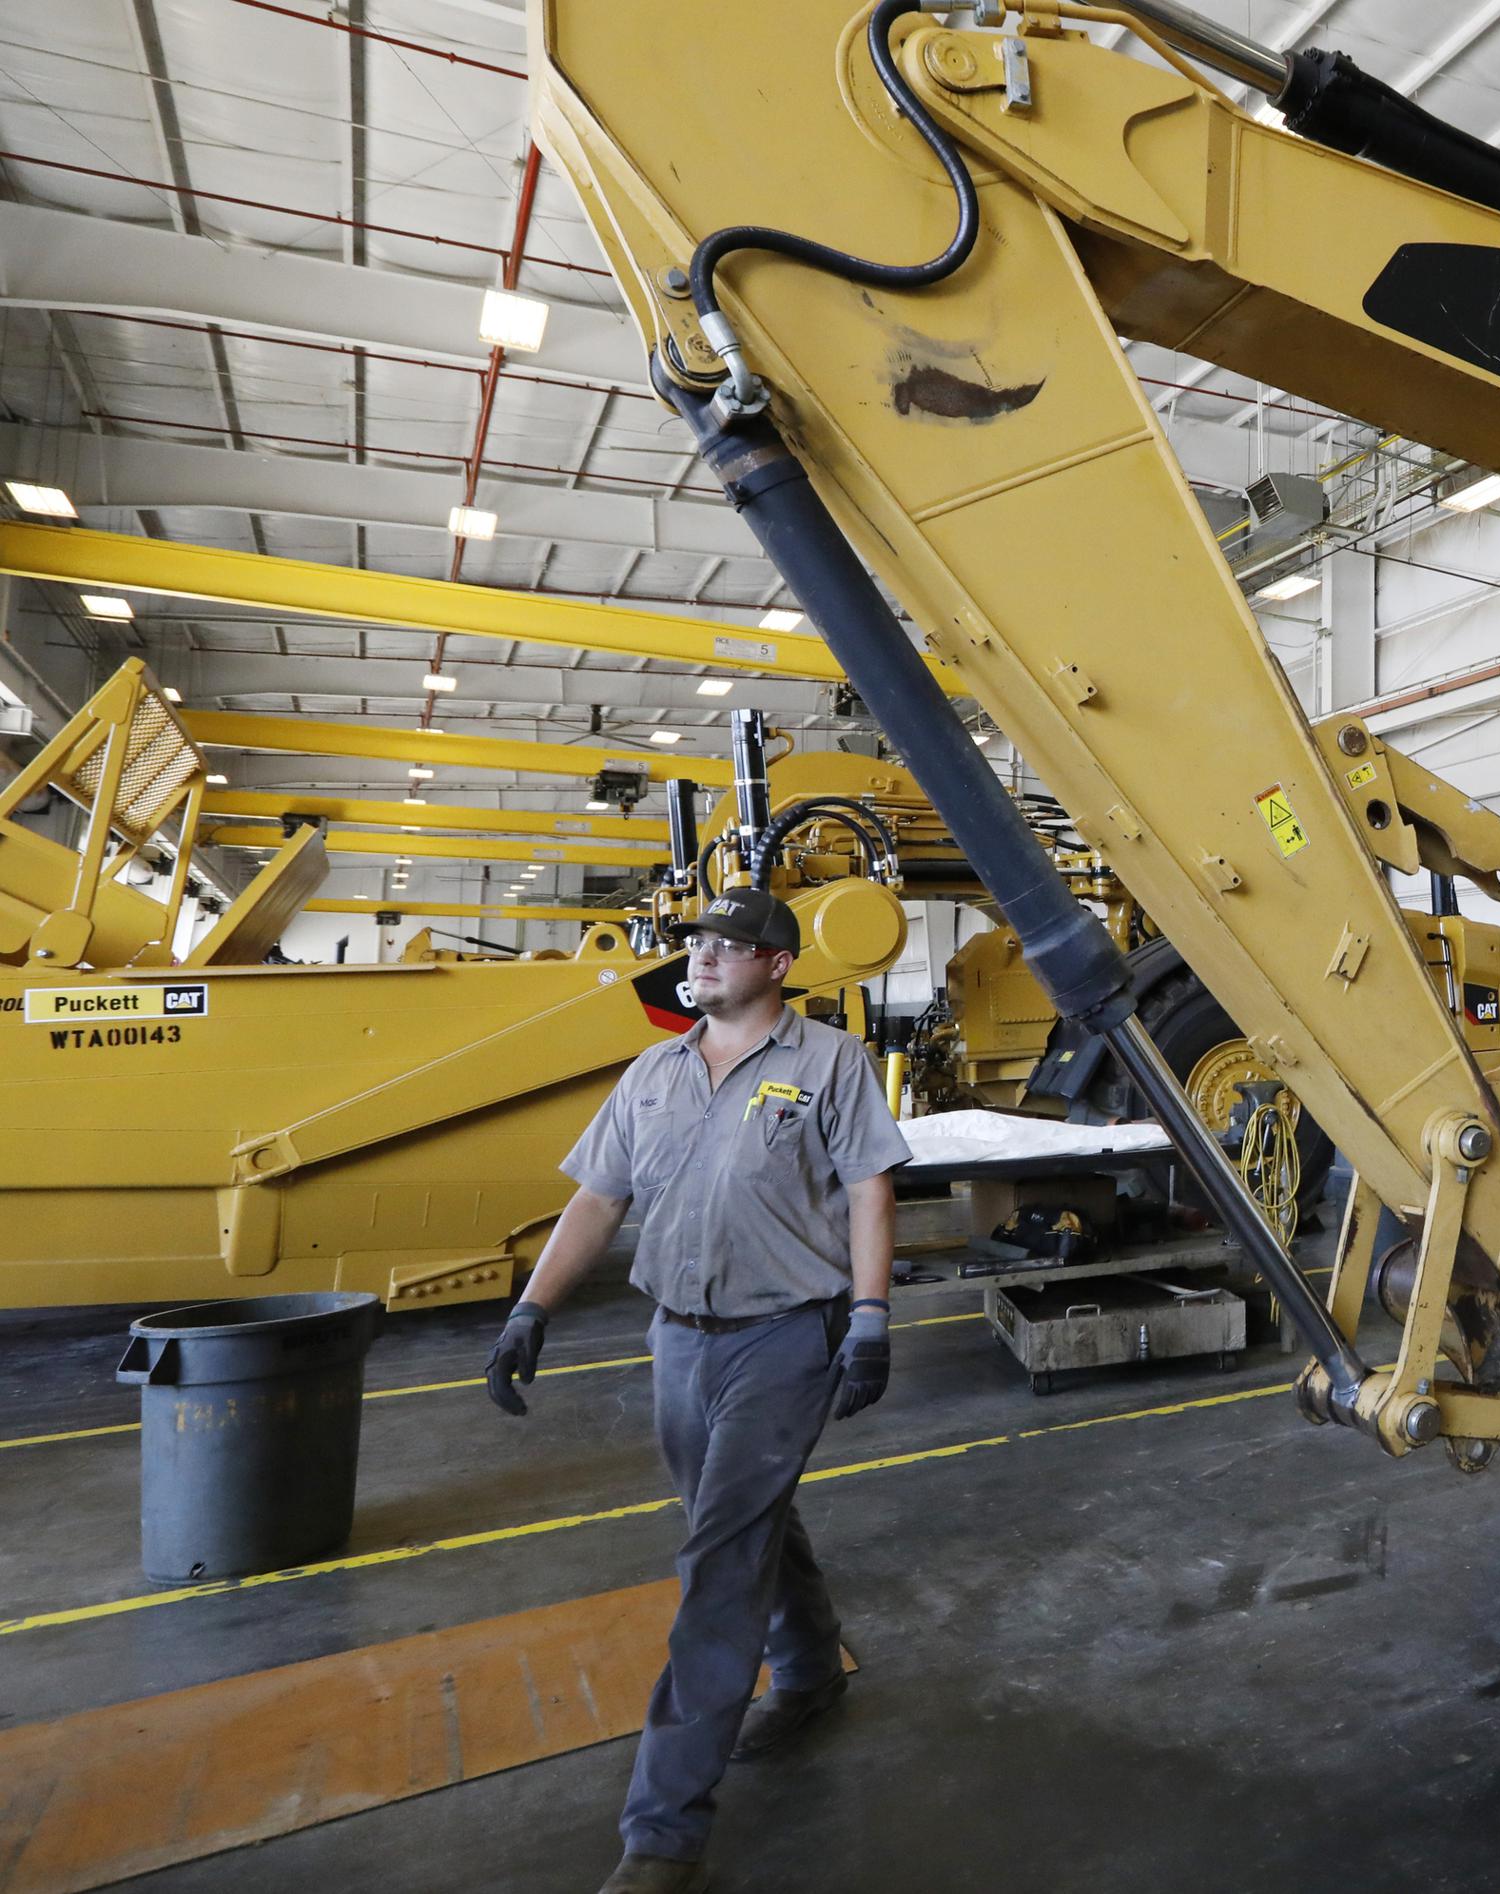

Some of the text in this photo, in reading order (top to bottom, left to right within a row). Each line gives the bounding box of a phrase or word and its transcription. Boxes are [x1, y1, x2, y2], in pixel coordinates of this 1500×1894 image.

[707, 899, 740, 917] CAT
[54, 991, 204, 1013] Puckett CAT
[1477, 1003, 1498, 1020] CAT
[50, 1025, 182, 1050] WTA00143
[767, 1085, 812, 1103] Puckett CAT
